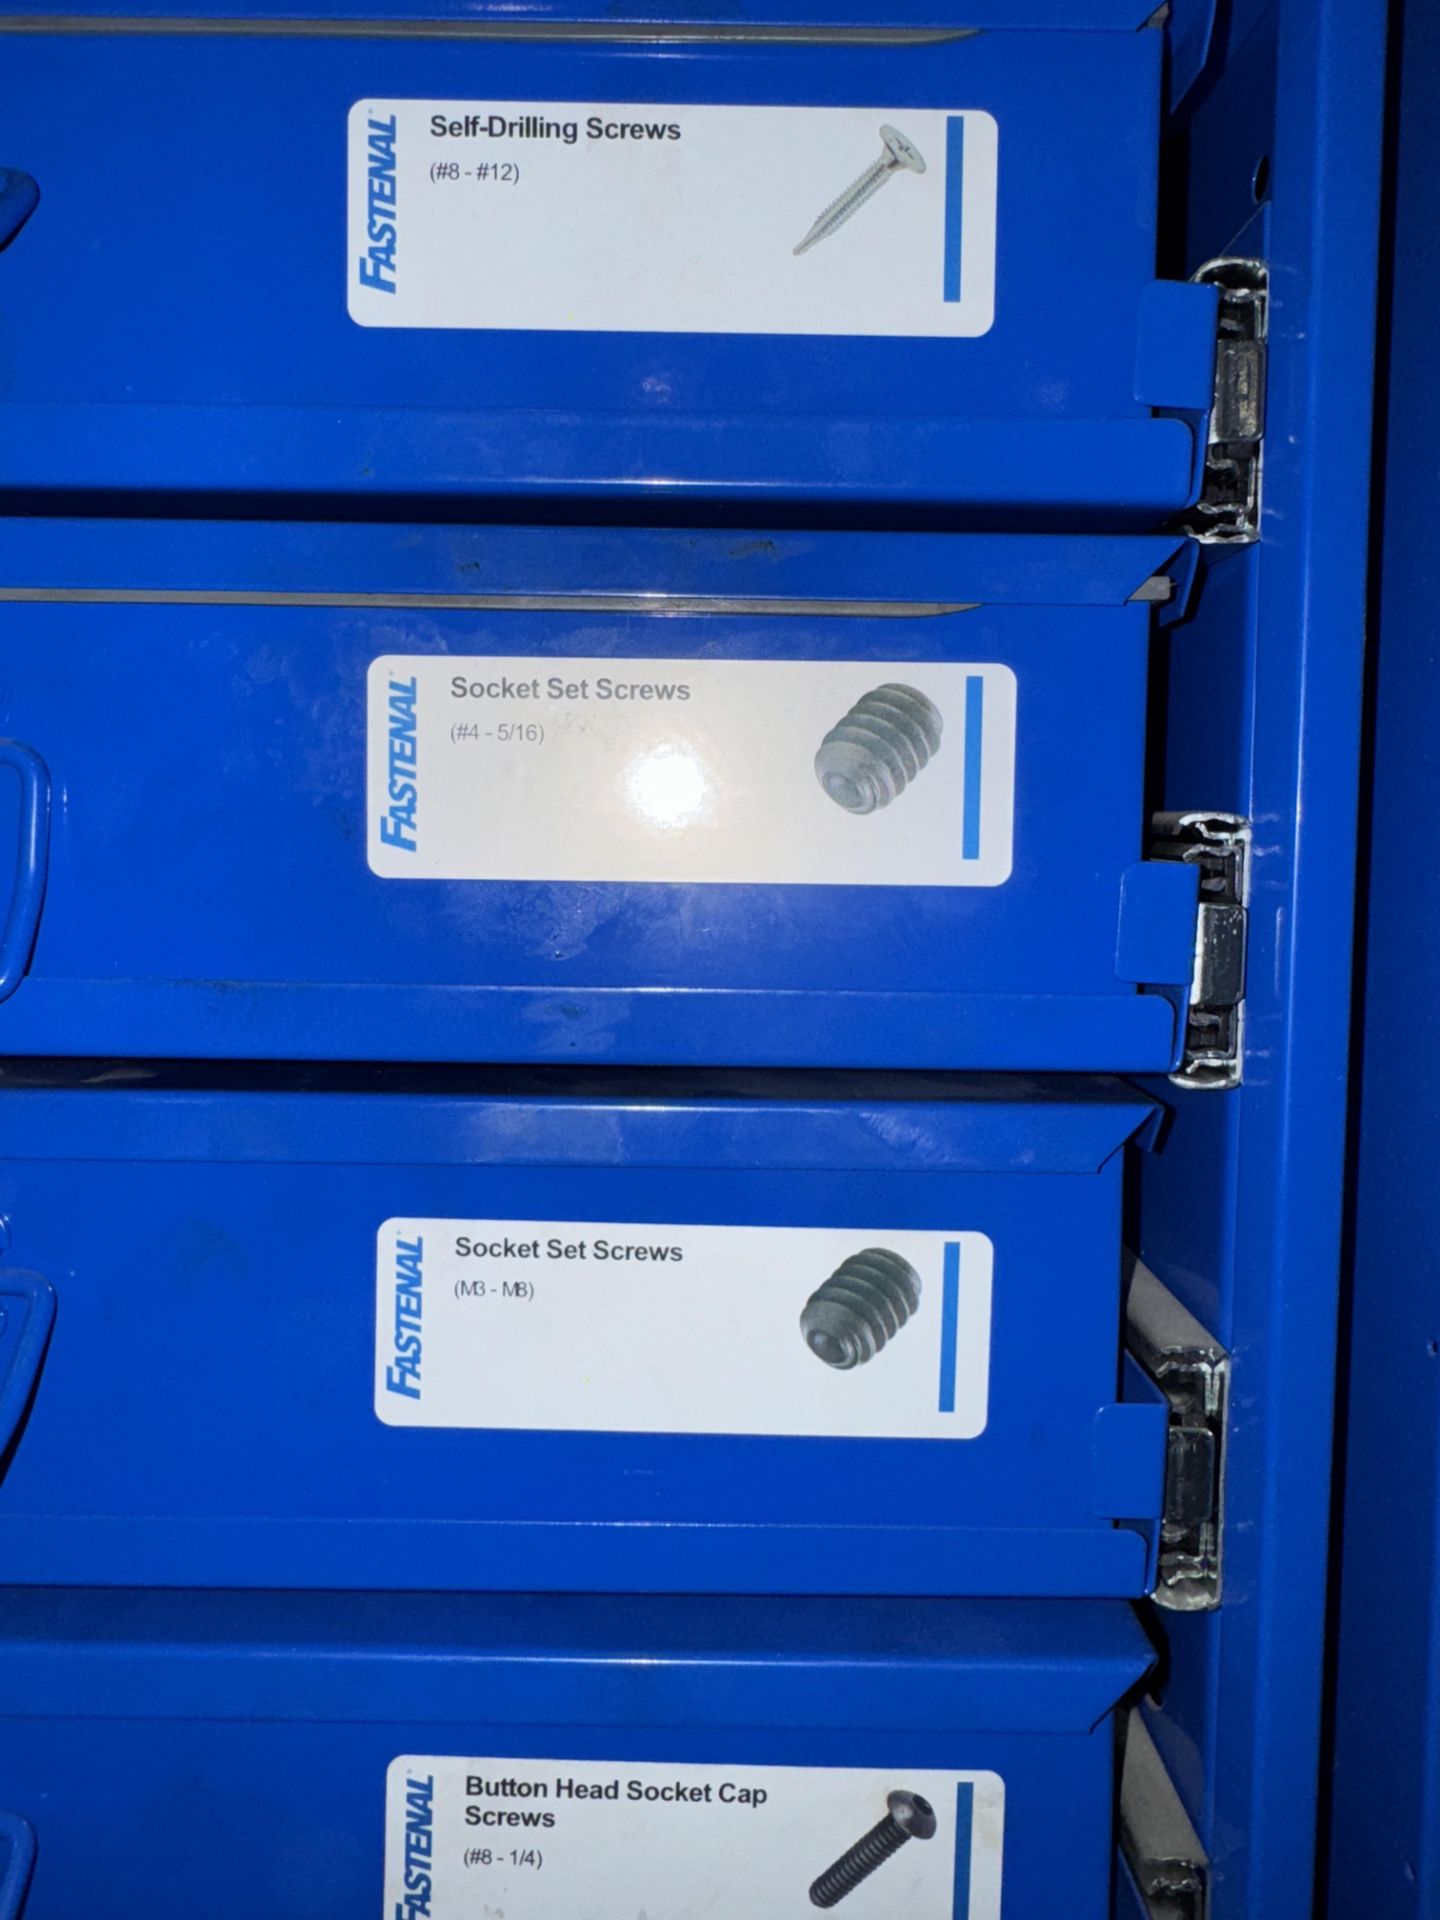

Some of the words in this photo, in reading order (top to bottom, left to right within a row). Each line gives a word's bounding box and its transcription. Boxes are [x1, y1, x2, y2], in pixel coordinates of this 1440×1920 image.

[430, 115, 578, 144] Self-Drilling
[586, 117, 681, 140] Screws
[430, 162, 459, 184] (#8
[477, 163, 519, 185] #12)
[359, 114, 397, 295] FASTENAL
[451, 676, 540, 699] Socket
[547, 677, 589, 700] Set
[595, 678, 690, 700] Screws
[450, 723, 479, 745] (#4
[498, 723, 544, 745] 5/16)
[380, 676, 417, 853] FASTENAL
[455, 1237, 540, 1259] Socket
[547, 1239, 586, 1260] Set
[593, 1240, 683, 1262] Screws
[454, 1279, 486, 1300] (M3
[502, 1281, 534, 1301] M8)
[386, 1236, 423, 1400] FASTENAL
[466, 1775, 548, 1798] Button
[556, 1778, 619, 1800] Head
[627, 1780, 712, 1803] Socket
[719, 1783, 768, 1808] Cap
[464, 1805, 556, 1828] Screws
[463, 1848, 492, 1868] (#8
[510, 1849, 543, 1870] 1/4)
